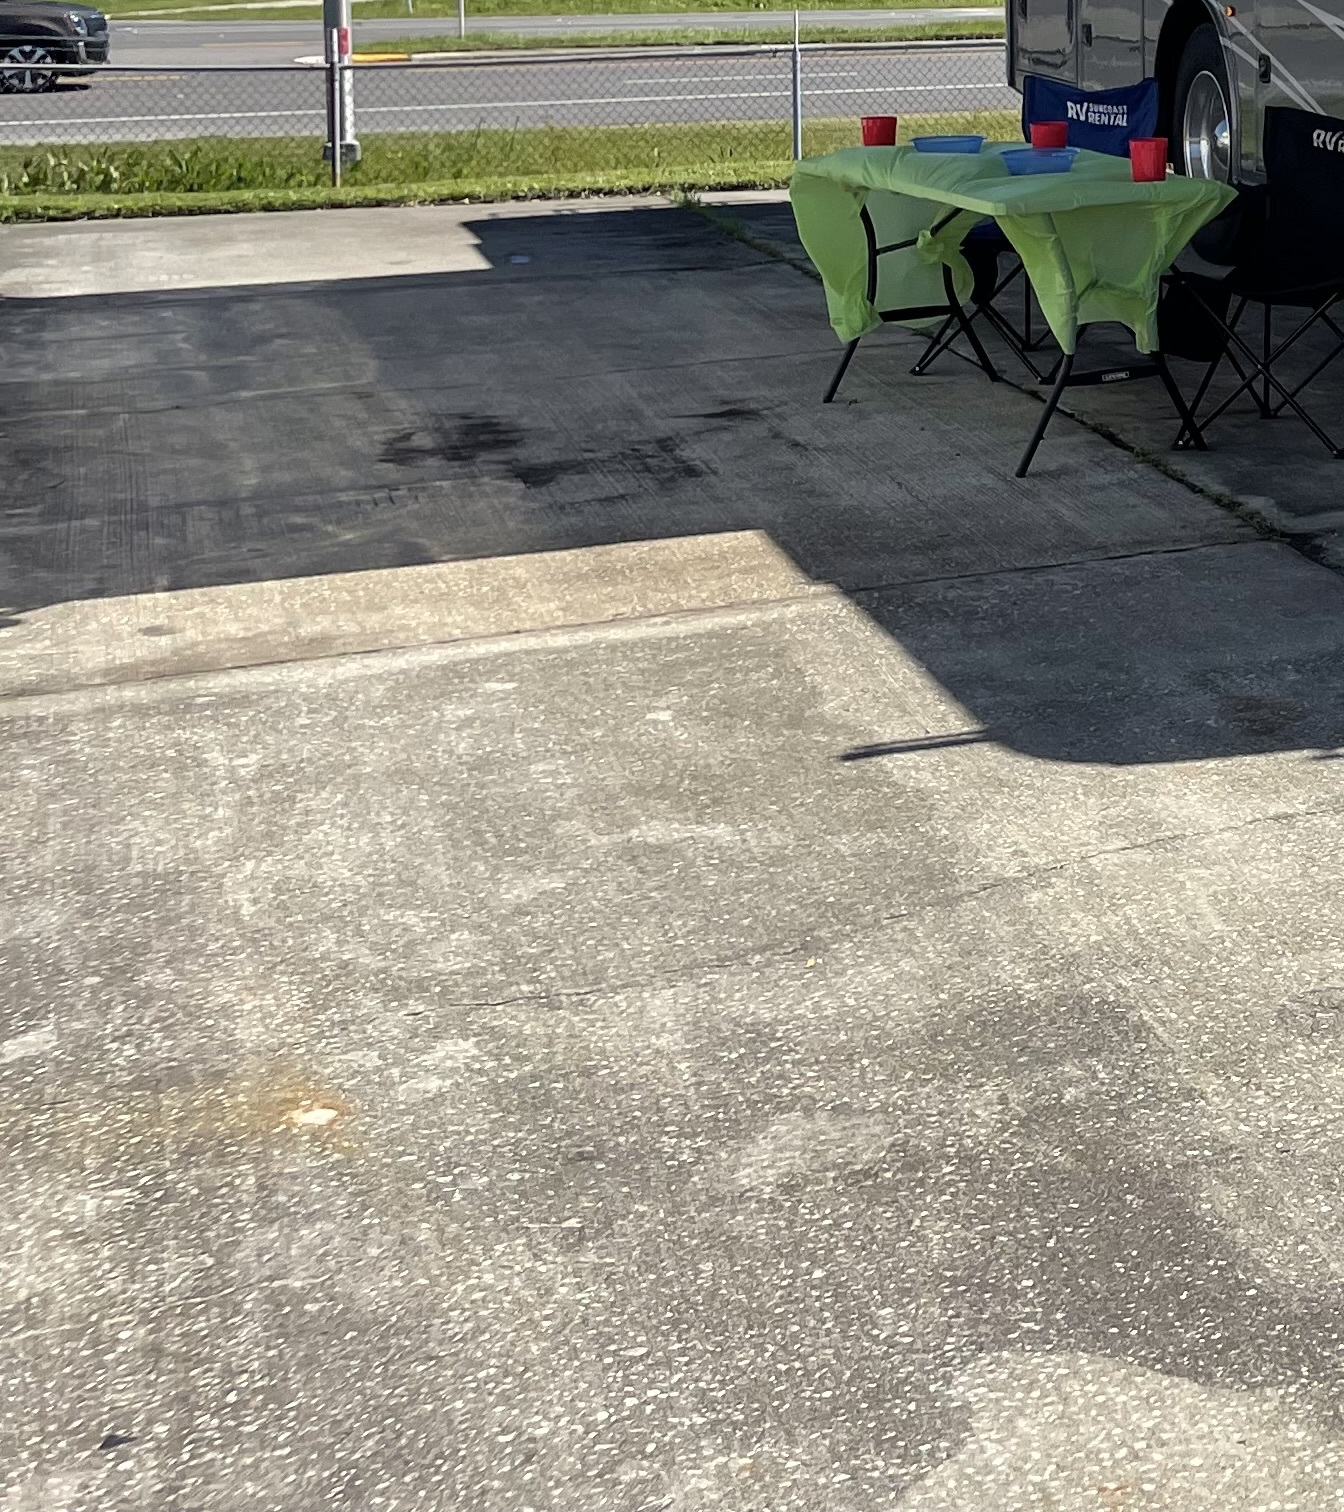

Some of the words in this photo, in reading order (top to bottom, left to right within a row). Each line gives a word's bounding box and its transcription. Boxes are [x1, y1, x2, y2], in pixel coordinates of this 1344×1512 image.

[1066, 100, 1088, 121] RV
[1087, 111, 1128, 126] RENTAL
[1088, 102, 1128, 114] SUNCOAST
[1312, 128, 1344, 150] RV
